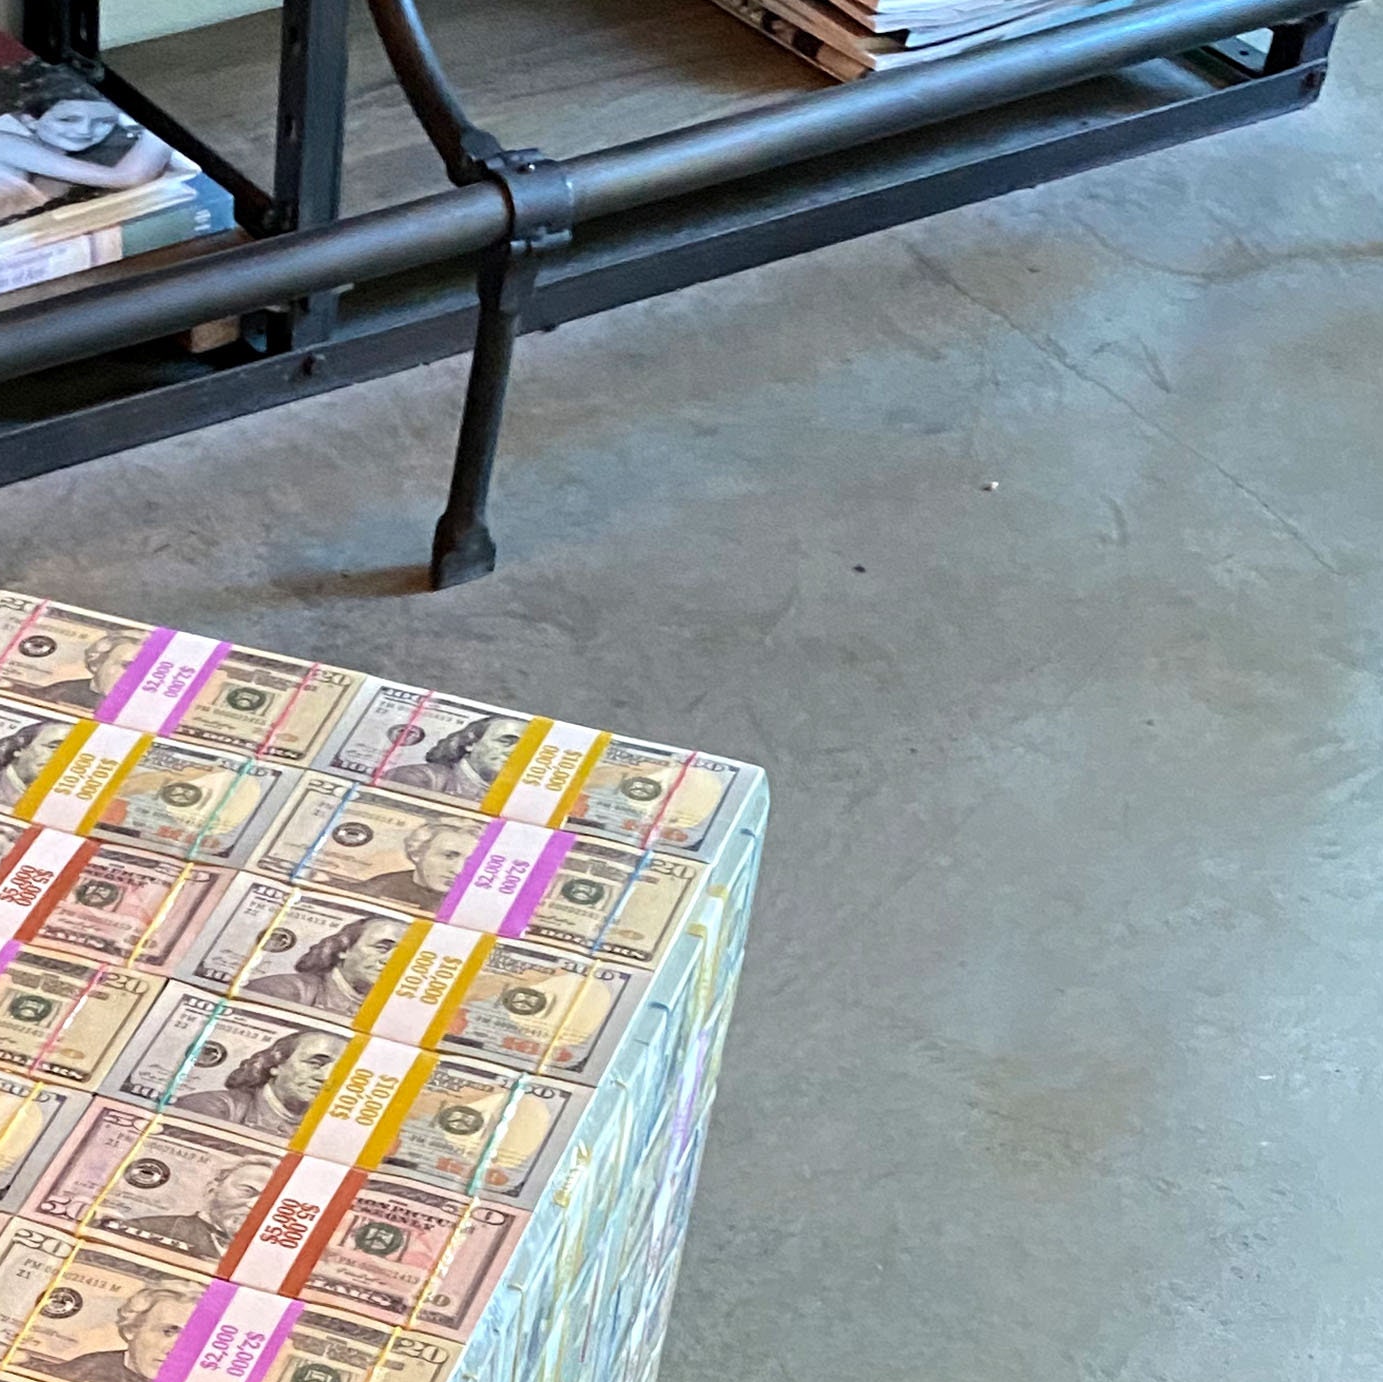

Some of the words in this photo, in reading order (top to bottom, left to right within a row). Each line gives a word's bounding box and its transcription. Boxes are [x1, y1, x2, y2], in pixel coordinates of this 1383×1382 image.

[140, 661, 175, 693] $2,000
[160, 666, 195, 698] $2,000
[53, 752, 96, 796] $10,000
[75, 757, 120, 802] $10,000
[522, 744, 560, 787] $10,000
[544, 749, 583, 792] $10,000
[13, 868, 54, 907] $5,000
[473, 854, 506, 889] $2,000
[496, 859, 530, 895] $2,000
[648, 858, 699, 880] 20
[103, 972, 152, 995] 20
[395, 949, 438, 999] $10,000
[418, 955, 462, 1006] $10,000
[329, 1067, 375, 1120] $10,000
[354, 1074, 399, 1127] $10,000
[103, 1219, 195, 1252] FIFTY
[260, 1197, 303, 1245] $5,000
[277, 1202, 320, 1250] $5,000
[10, 1227, 77, 1259] 20
[199, 1323, 239, 1370] $2,000
[225, 1331, 265, 1378] $2,000
[394, 1336, 451, 1366] 20
